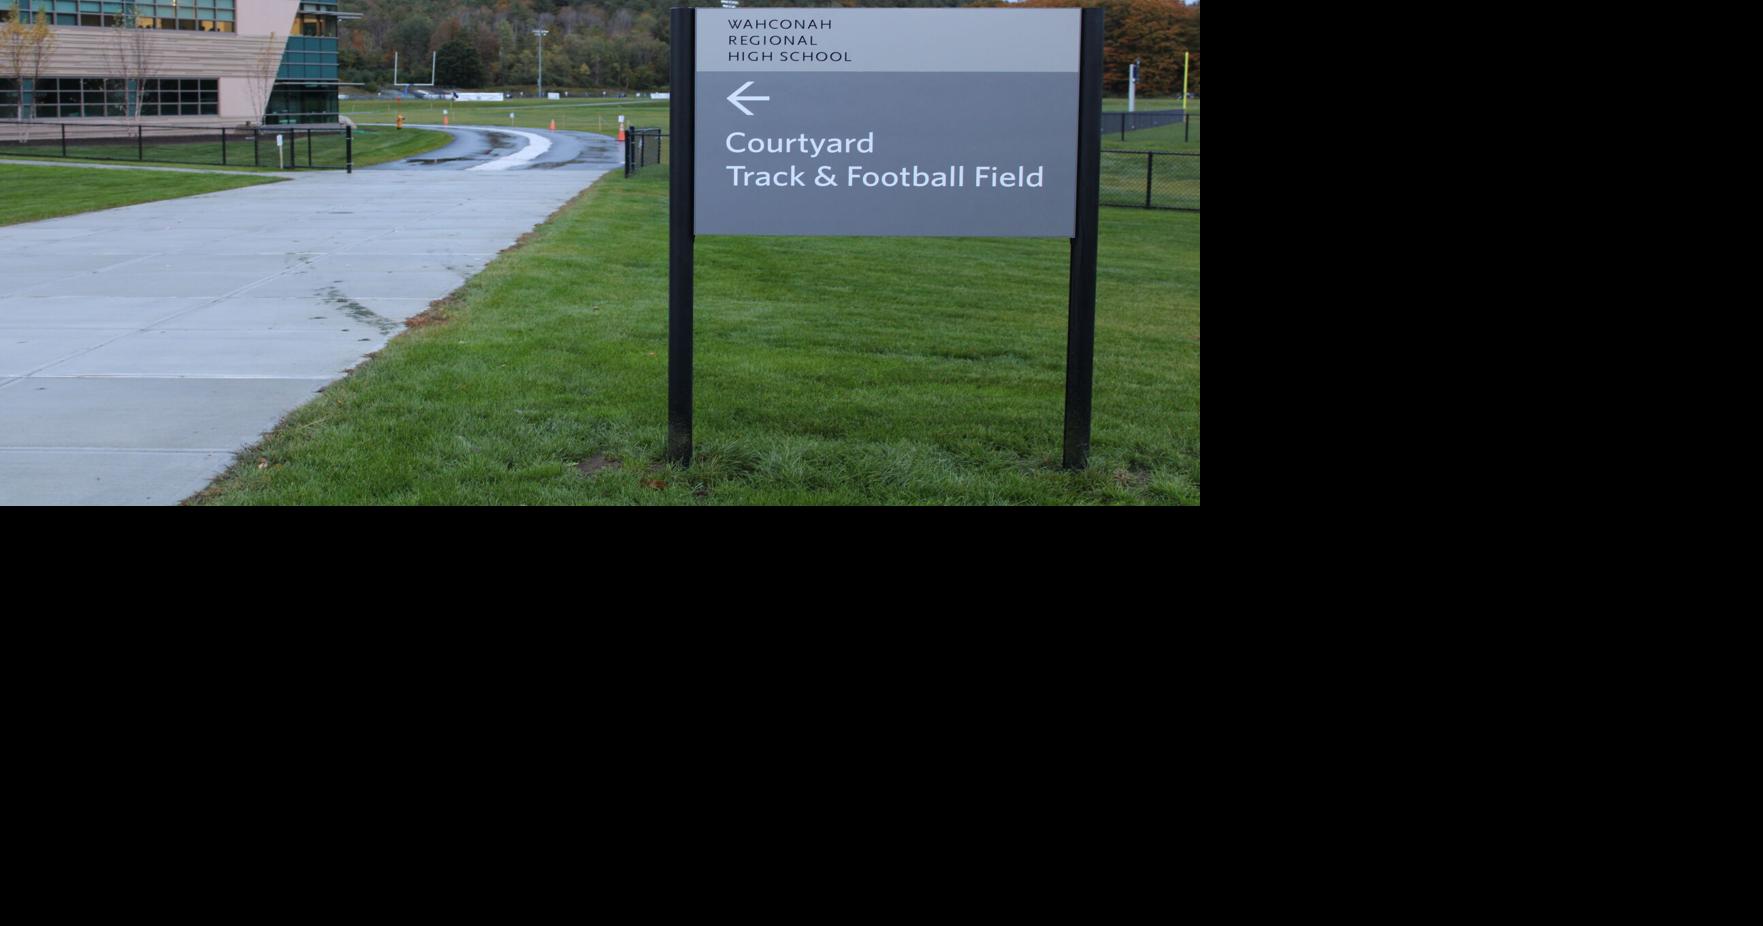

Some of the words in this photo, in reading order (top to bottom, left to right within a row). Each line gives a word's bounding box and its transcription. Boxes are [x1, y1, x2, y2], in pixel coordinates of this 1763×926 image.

[727, 18, 832, 30] WAHCONAH
[728, 34, 818, 46] REGIONAL
[728, 51, 773, 62] HIGH
[779, 51, 853, 63] SCHOOL
[725, 131, 874, 159] Courtyard
[725, 164, 806, 187] Track
[814, 165, 839, 187] &
[847, 165, 965, 188] Football
[975, 165, 1044, 188] Field
